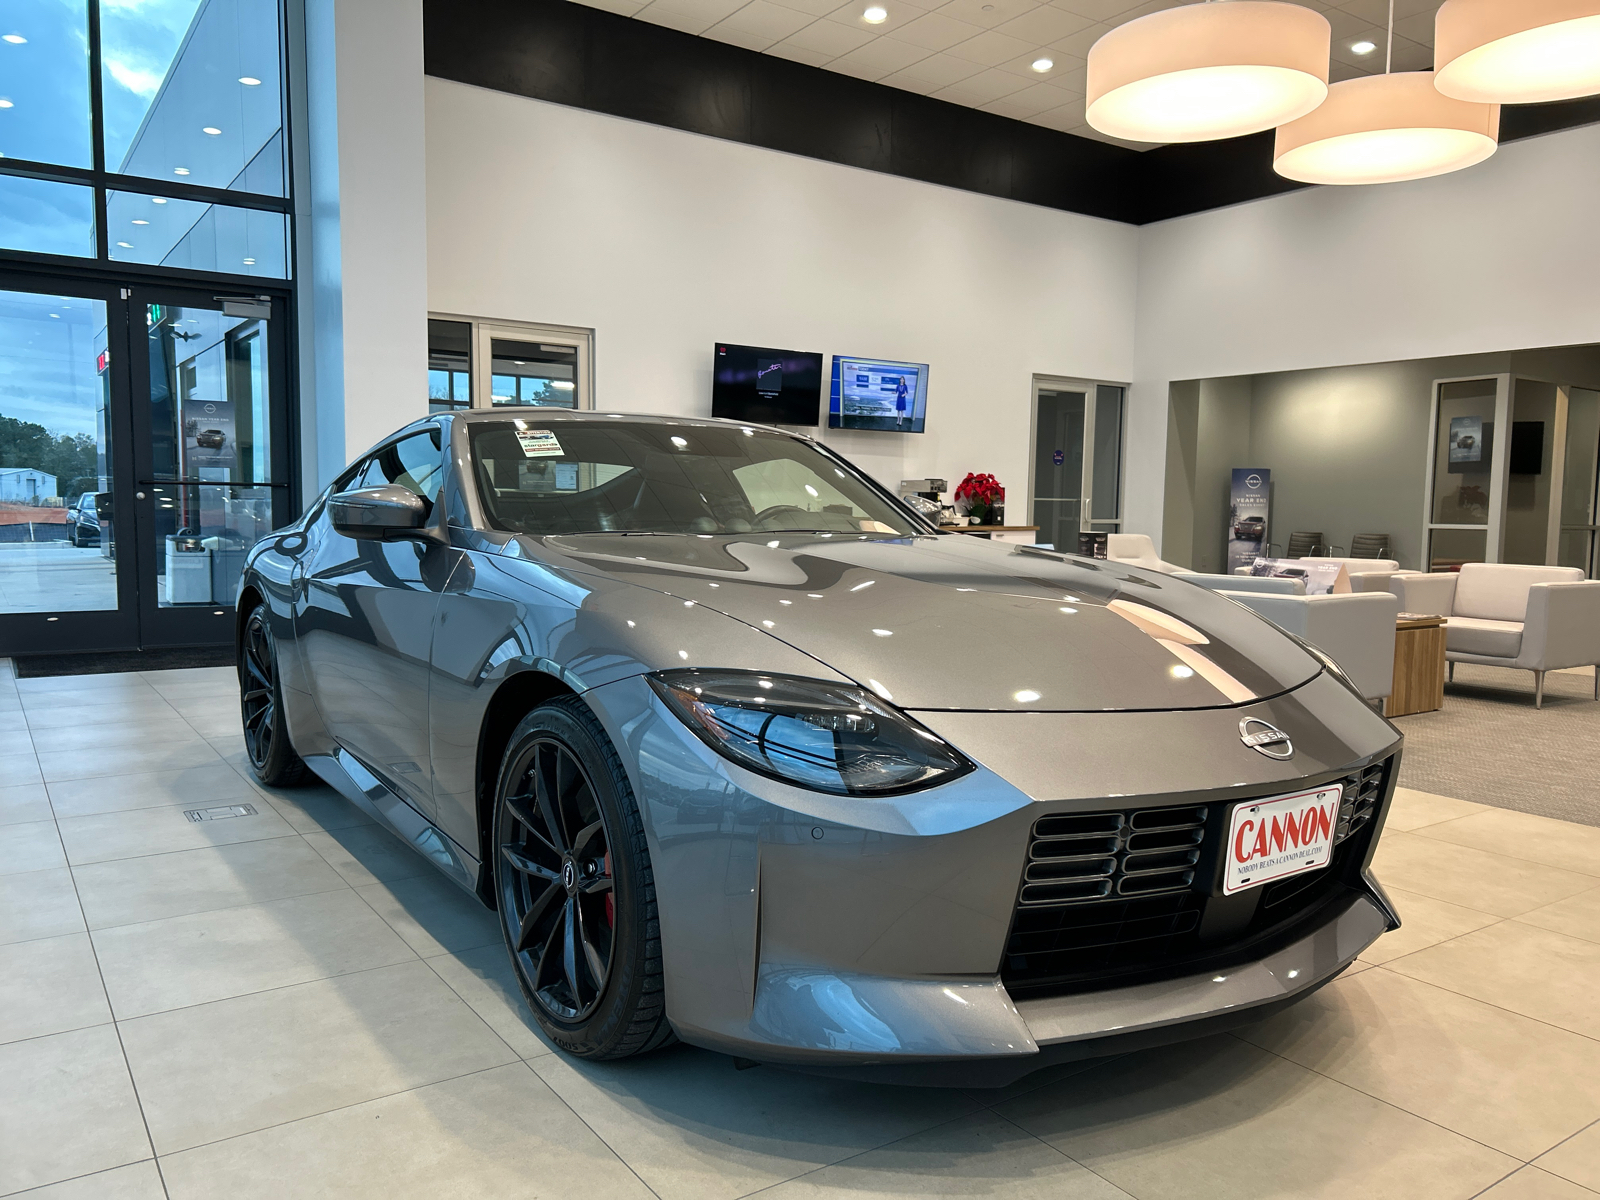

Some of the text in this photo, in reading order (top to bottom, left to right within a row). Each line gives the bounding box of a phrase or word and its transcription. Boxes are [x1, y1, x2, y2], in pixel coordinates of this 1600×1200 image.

[1244, 731, 1290, 745] NISSAN
[1235, 802, 1335, 864] CANNON
[1237, 863, 1258, 875] NOBODY
[1260, 858, 1275, 870] BEATS
[1280, 852, 1299, 864] CANNON
